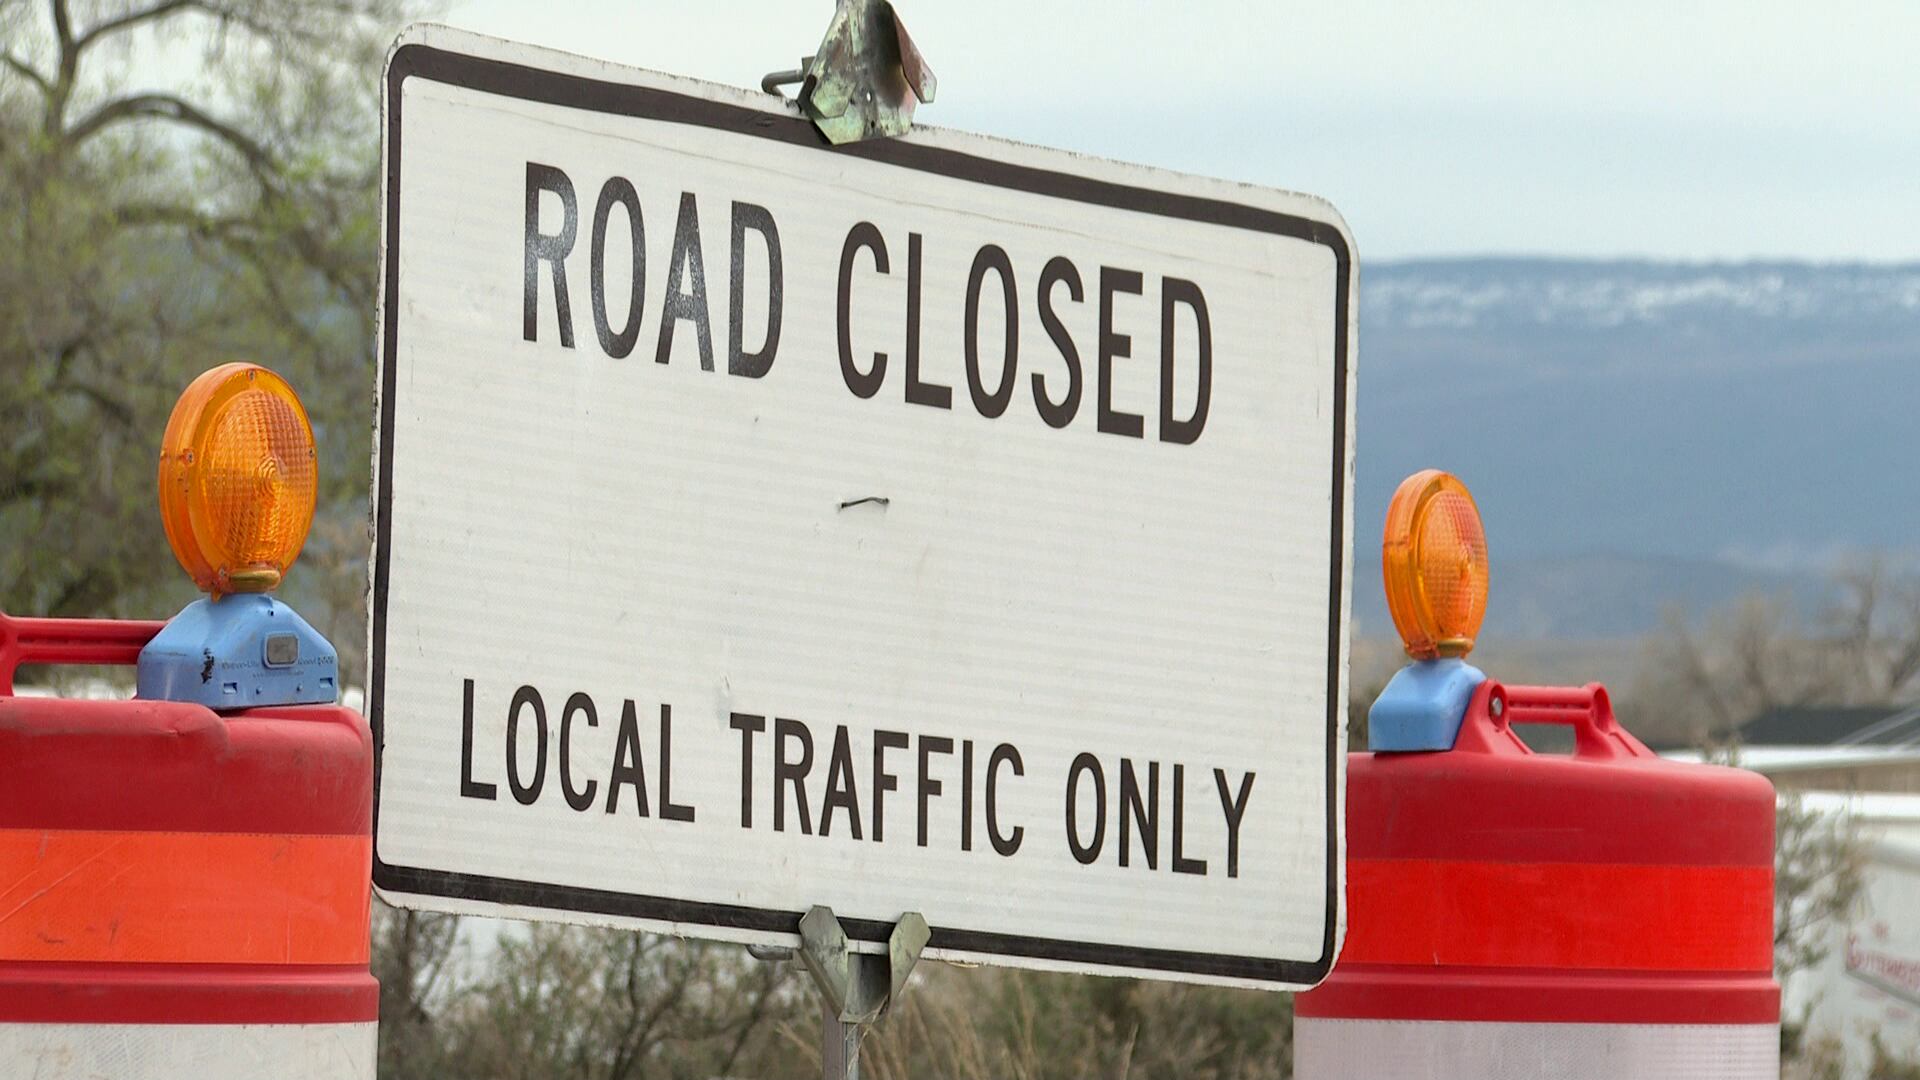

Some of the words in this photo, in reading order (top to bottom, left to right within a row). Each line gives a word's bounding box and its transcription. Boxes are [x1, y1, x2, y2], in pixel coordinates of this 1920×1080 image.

[524, 161, 783, 378] ROAD
[837, 221, 1212, 446] CLOSED
[460, 678, 696, 823] LOCAL
[729, 711, 1025, 857] TRAFFIC
[1065, 751, 1256, 879] ONLY
